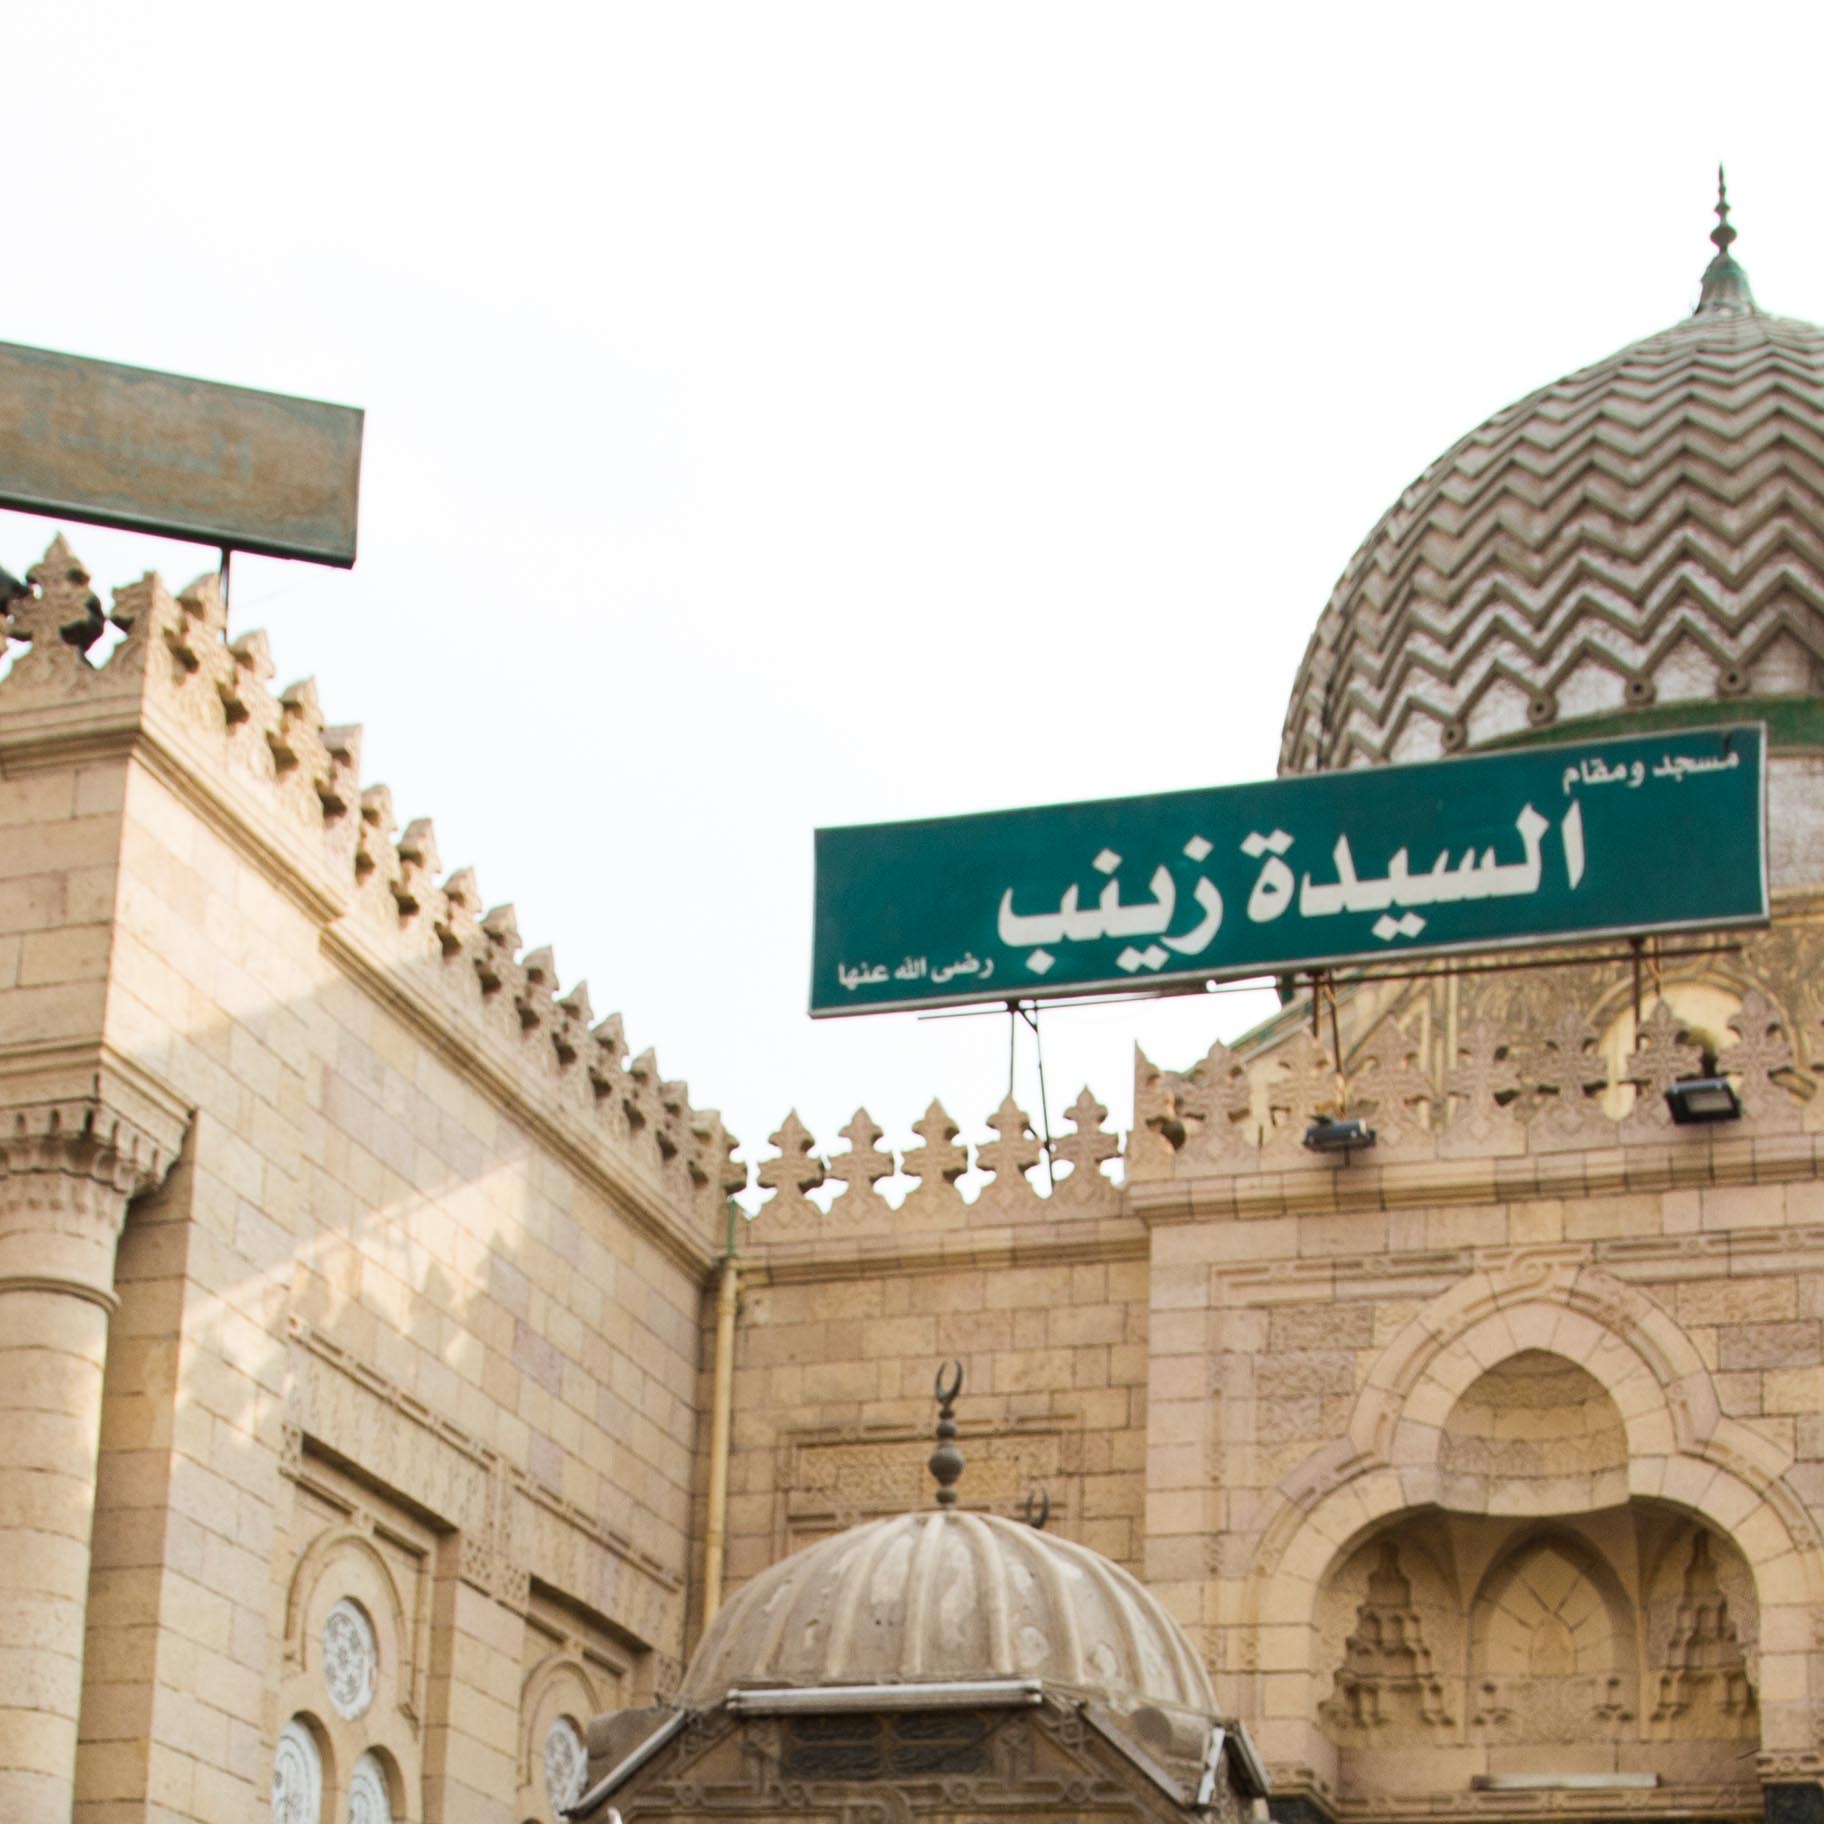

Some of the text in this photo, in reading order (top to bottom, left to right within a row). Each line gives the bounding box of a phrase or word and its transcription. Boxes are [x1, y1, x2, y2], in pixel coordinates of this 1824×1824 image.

[1562, 750, 1740, 796] مسجد ومقام
[996, 797, 1588, 978] السيدة زينب
[837, 960, 890, 991] عنها
[893, 955, 928, 981] الله
